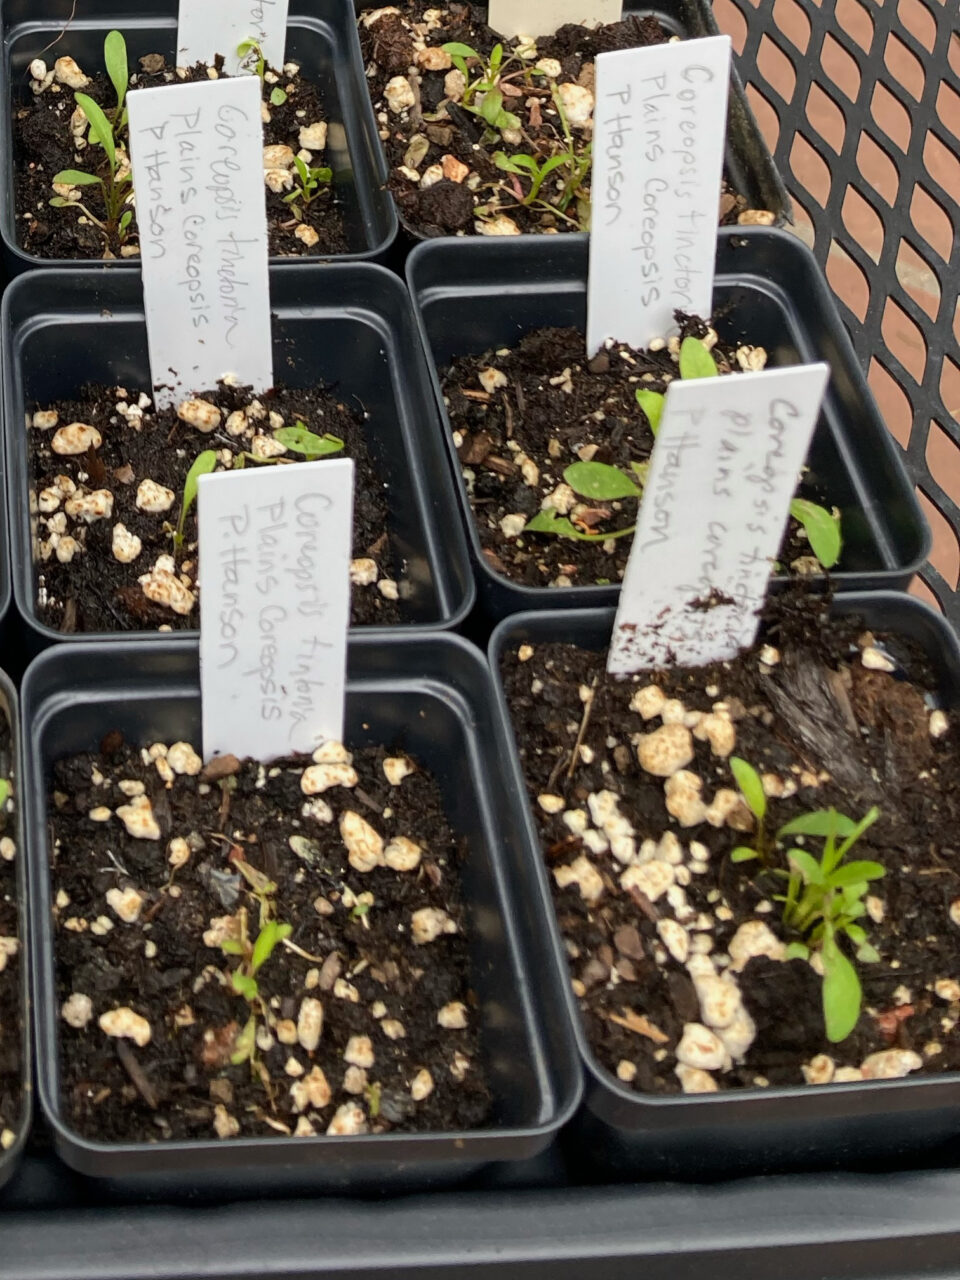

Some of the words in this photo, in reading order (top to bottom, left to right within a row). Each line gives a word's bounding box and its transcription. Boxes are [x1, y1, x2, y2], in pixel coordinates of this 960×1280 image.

[169, 106, 203, 205] Plains
[204, 103, 249, 221] Coreopsis
[602, 112, 633, 226] Hanson
[640, 72, 671, 163] Plains
[671, 63, 715, 198] Coreopsis
[142, 148, 173, 259] Hanson
[646, 432, 698, 552] Hanson
[743, 397, 803, 535] Coreopsis
[253, 495, 289, 596] Plains
[282, 491, 334, 617] Coreopsis
[216, 543, 252, 670] Hanson
